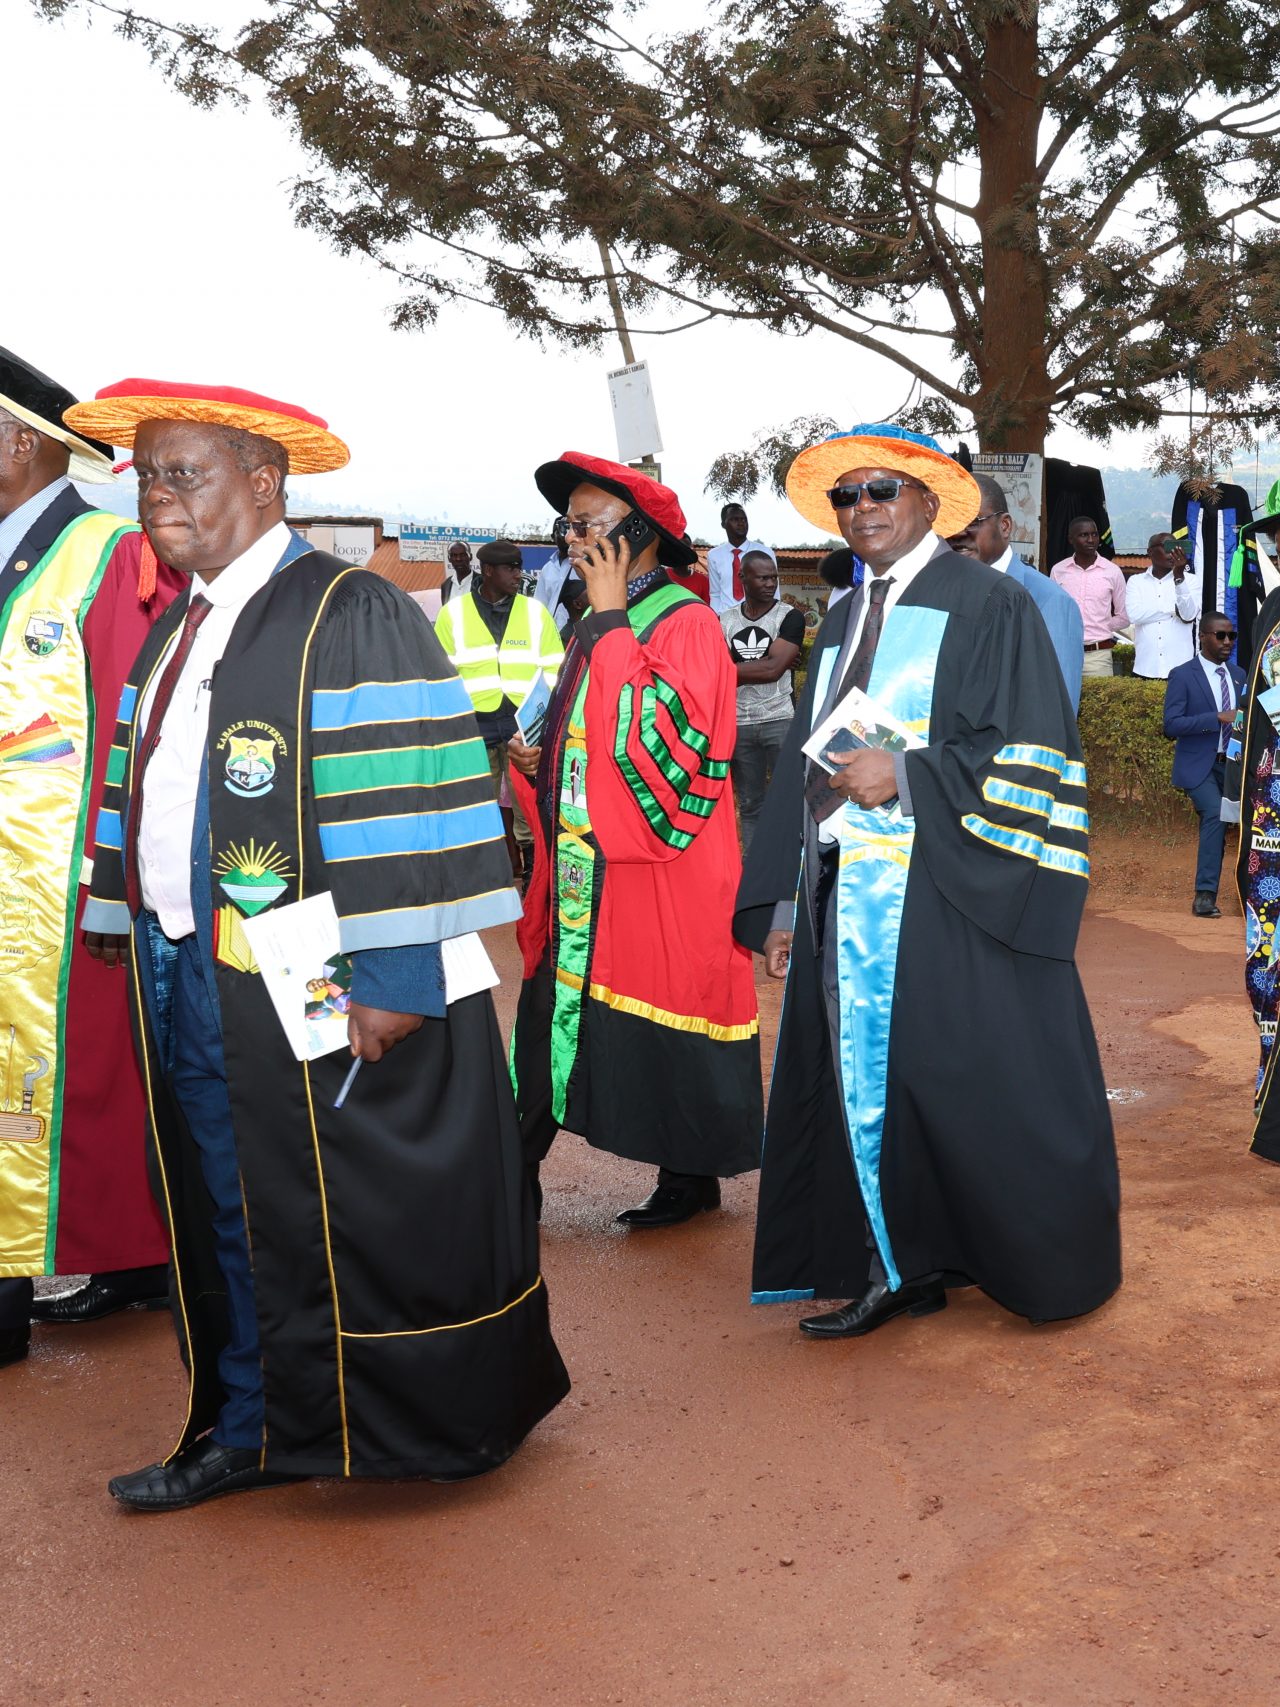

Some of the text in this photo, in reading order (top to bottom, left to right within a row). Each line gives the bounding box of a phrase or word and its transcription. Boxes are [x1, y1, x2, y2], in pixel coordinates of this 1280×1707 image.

[402, 526, 438, 535] LITTLE
[459, 528, 495, 537] FOODS
[216, 720, 287, 756] KABALE UNIVERSITY
